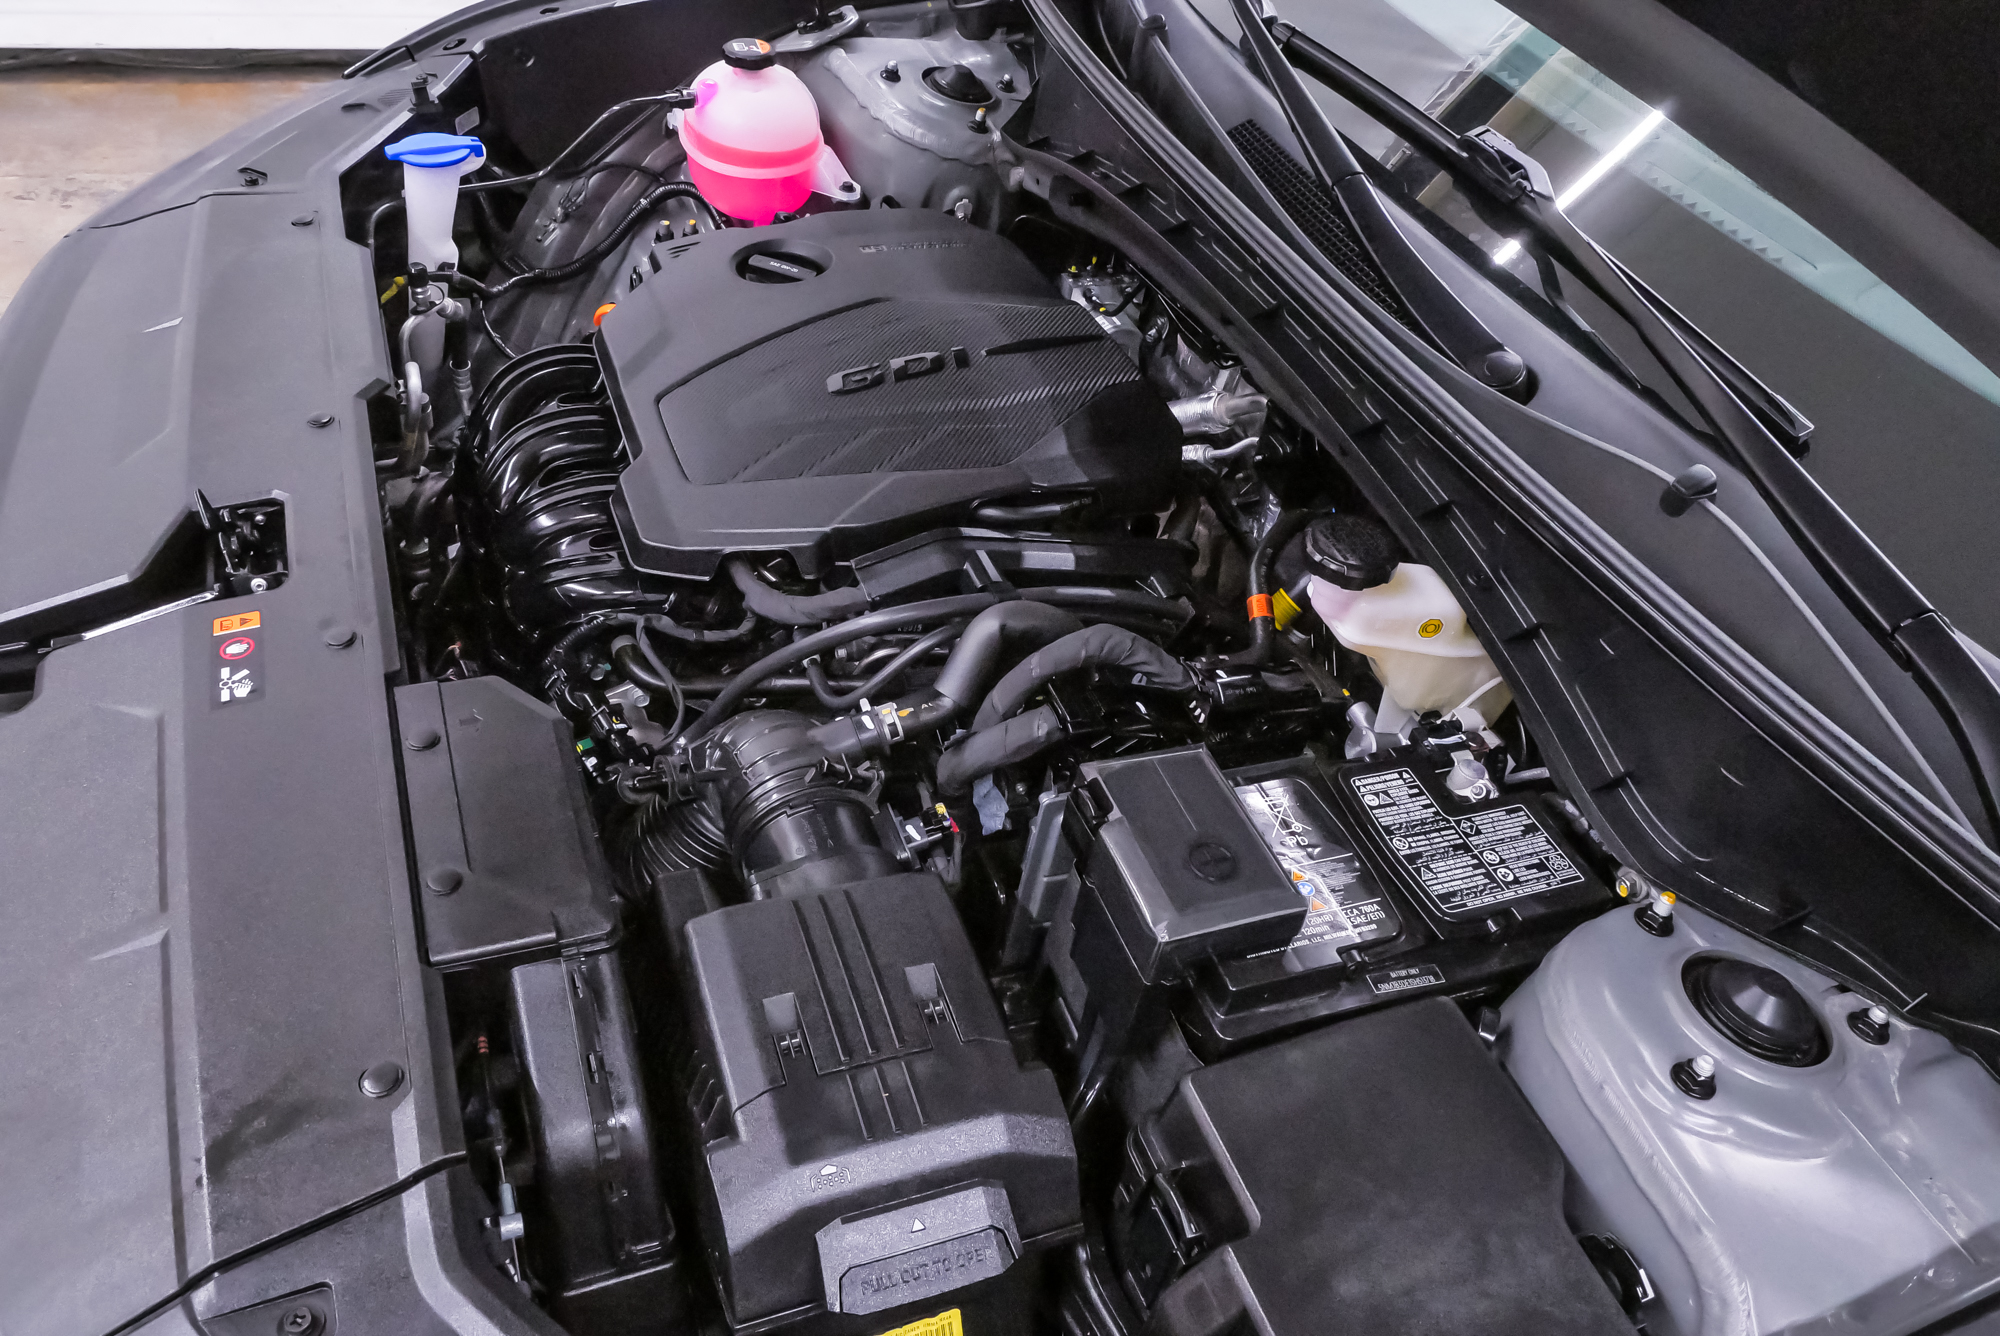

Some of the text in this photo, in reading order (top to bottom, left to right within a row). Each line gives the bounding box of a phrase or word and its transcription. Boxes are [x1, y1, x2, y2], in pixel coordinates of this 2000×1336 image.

[826, 346, 970, 395] GDI
[1286, 834, 1309, 847] Pb
[1359, 903, 1381, 914] 760A
[1306, 914, 1333, 926] (20HR)
[1302, 924, 1330, 936] 120min
[860, 1273, 898, 1296] PULL
[900, 1262, 929, 1284] OUT
[931, 1257, 951, 1275] TO
